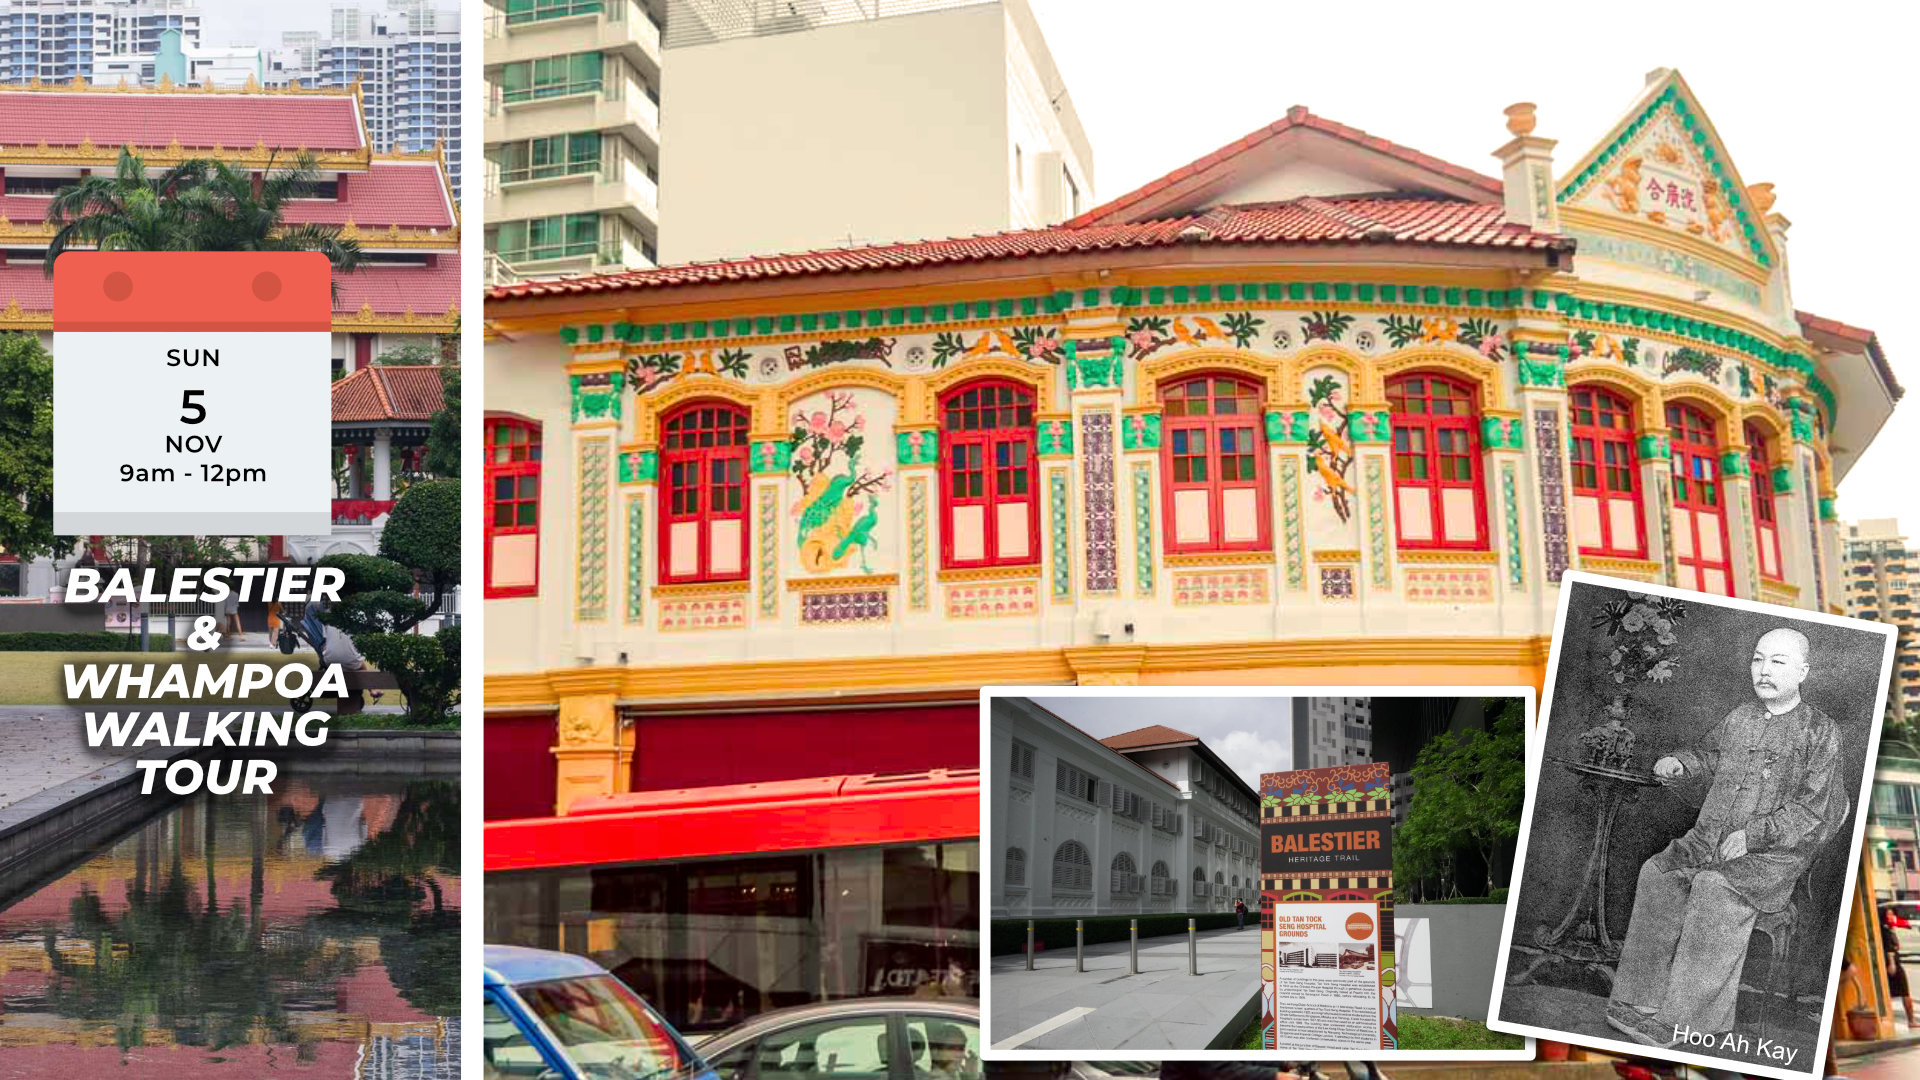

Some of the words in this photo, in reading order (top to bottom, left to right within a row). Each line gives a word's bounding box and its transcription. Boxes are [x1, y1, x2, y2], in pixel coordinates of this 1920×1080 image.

[1271, 830, 1380, 853] BALESTIER
[1288, 855, 1331, 863] HERITAGE
[1334, 854, 1360, 862] TRAIL
